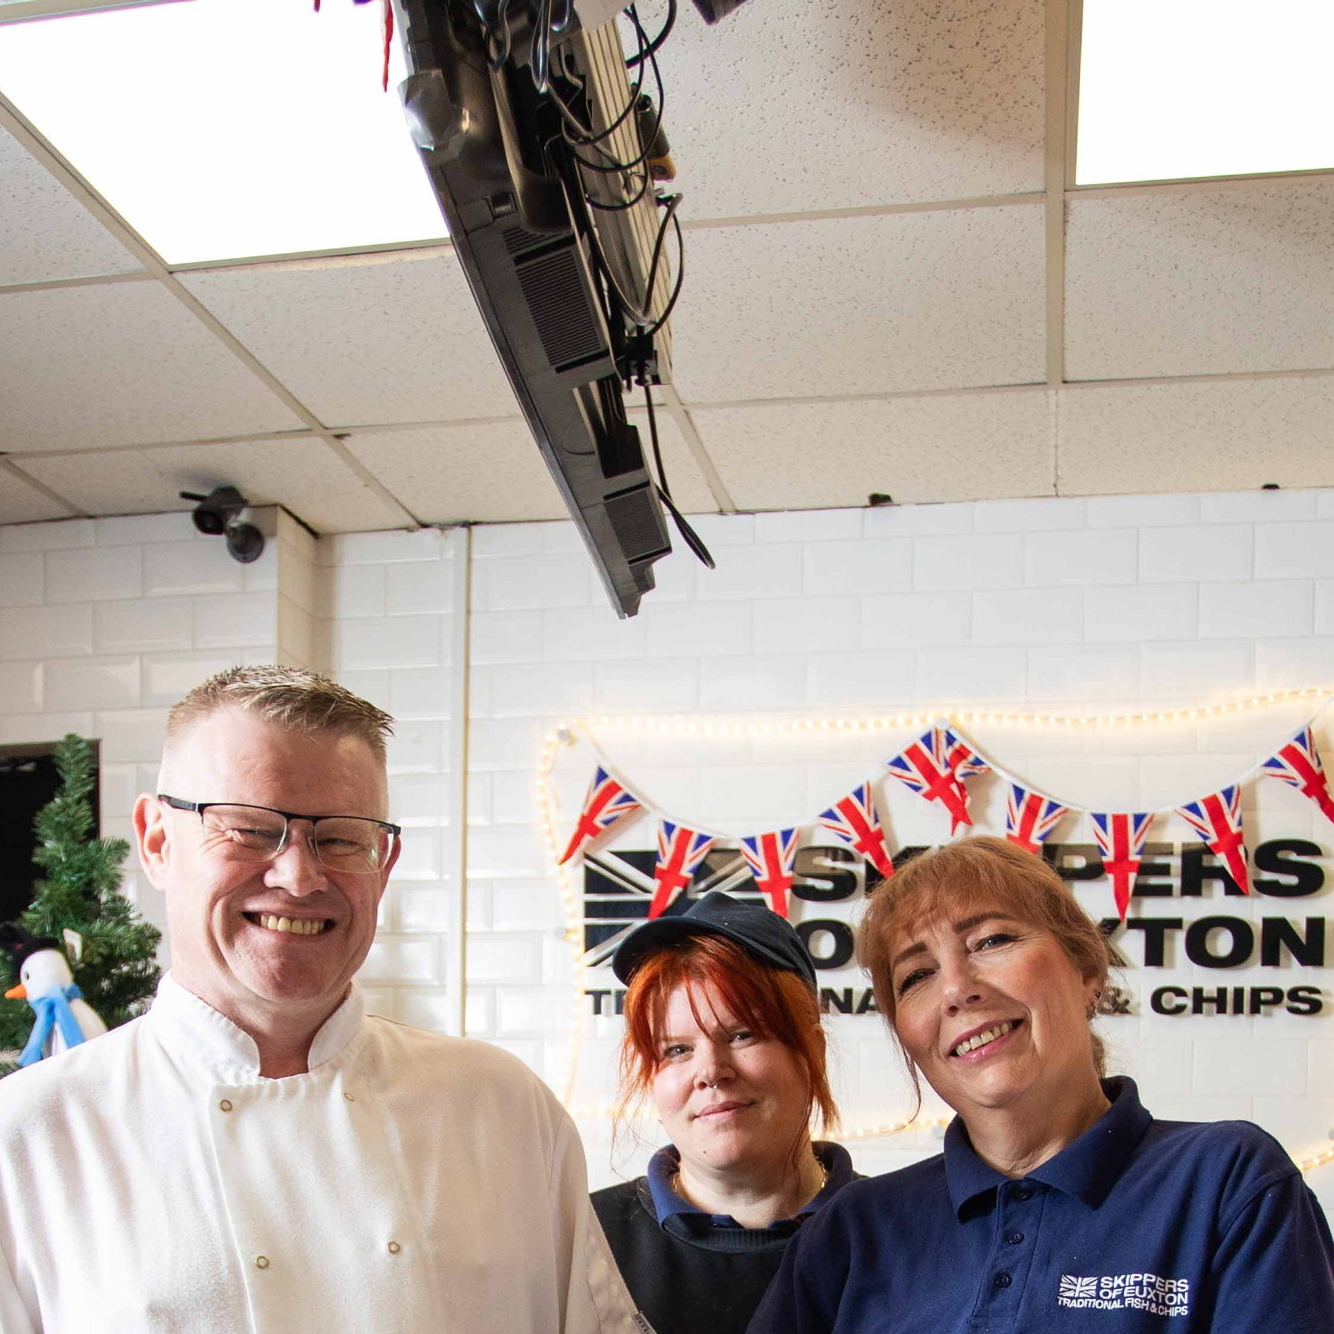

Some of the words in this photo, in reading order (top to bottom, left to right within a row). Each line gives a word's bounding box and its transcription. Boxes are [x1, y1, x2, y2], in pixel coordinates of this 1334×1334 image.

[1151, 985, 1323, 1015] CHIPS
[1100, 1273, 1189, 1293] SKIPPERS
[1099, 1287, 1122, 1300] OF
[1123, 1286, 1189, 1306] EUXTON
[1057, 1296, 1124, 1310] TRADITIONAL
[1125, 1297, 1149, 1310] FISH
[1150, 1303, 1158, 1314] &
[1158, 1305, 1189, 1317] CHIPS
